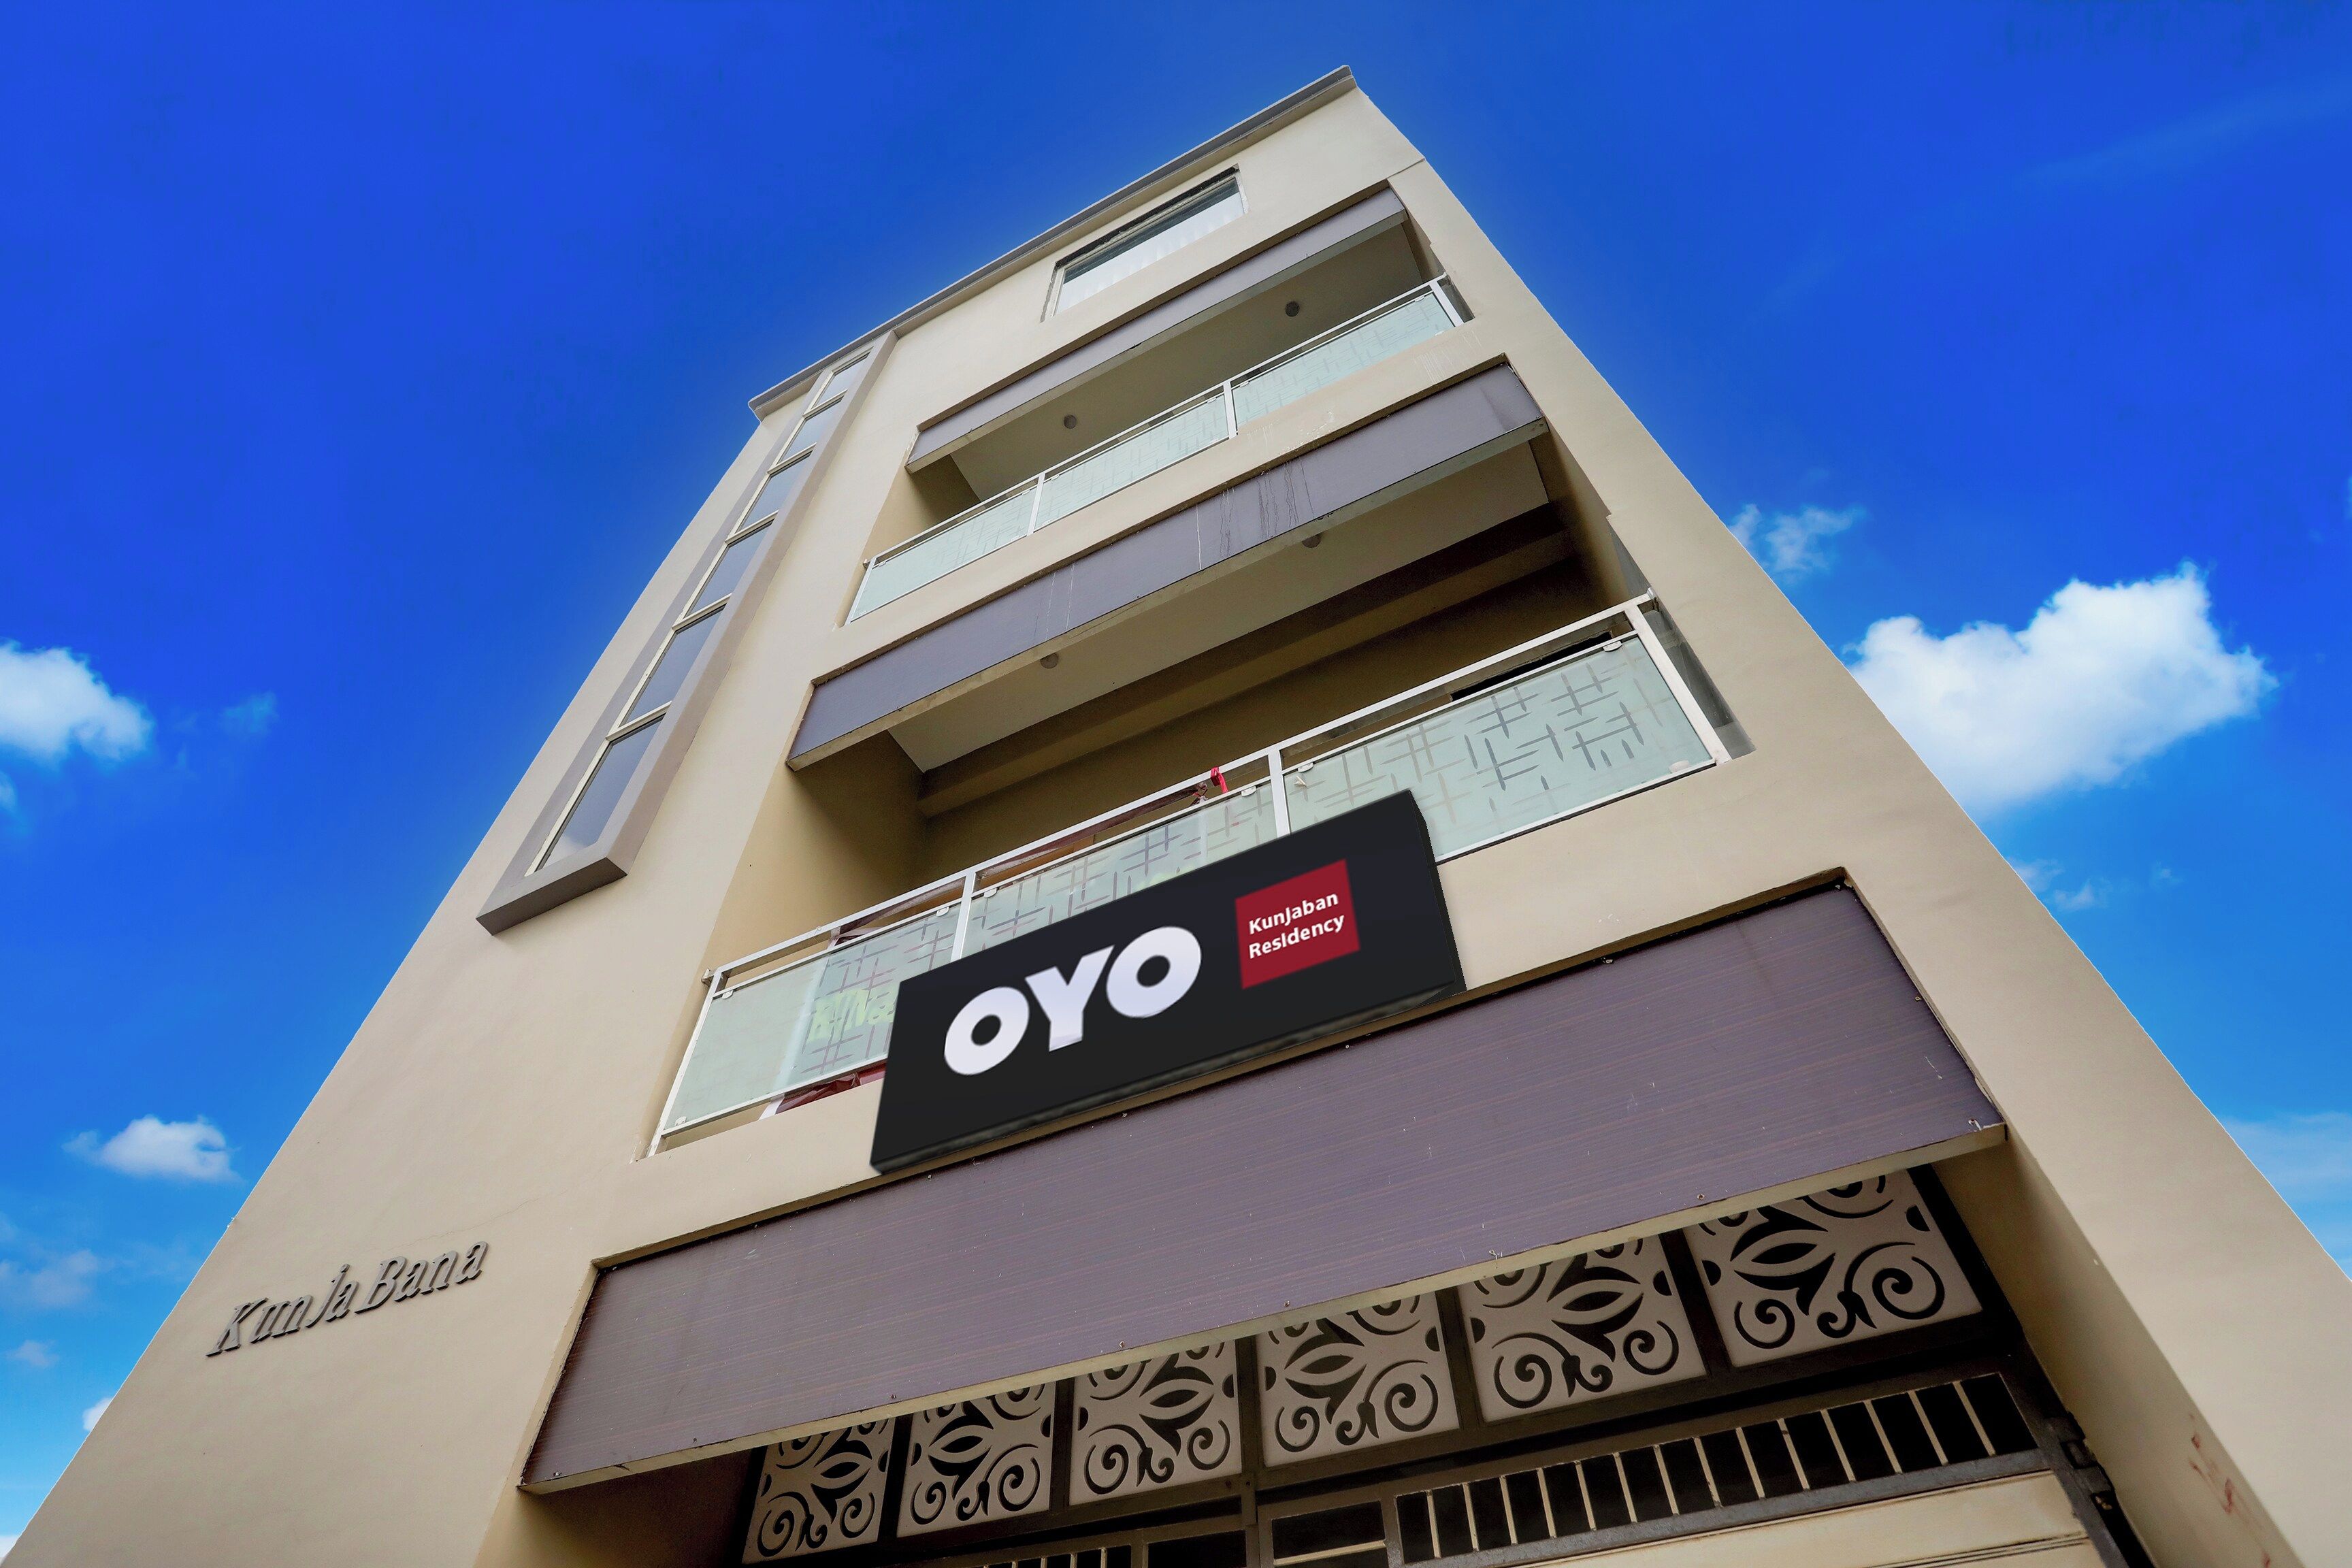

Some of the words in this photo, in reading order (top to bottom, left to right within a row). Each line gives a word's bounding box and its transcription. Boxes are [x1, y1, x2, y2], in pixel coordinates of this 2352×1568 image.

[1248, 915, 1345, 960] Residency
[944, 926, 1203, 1075] OYO
[354, 1241, 490, 1315] Bana
